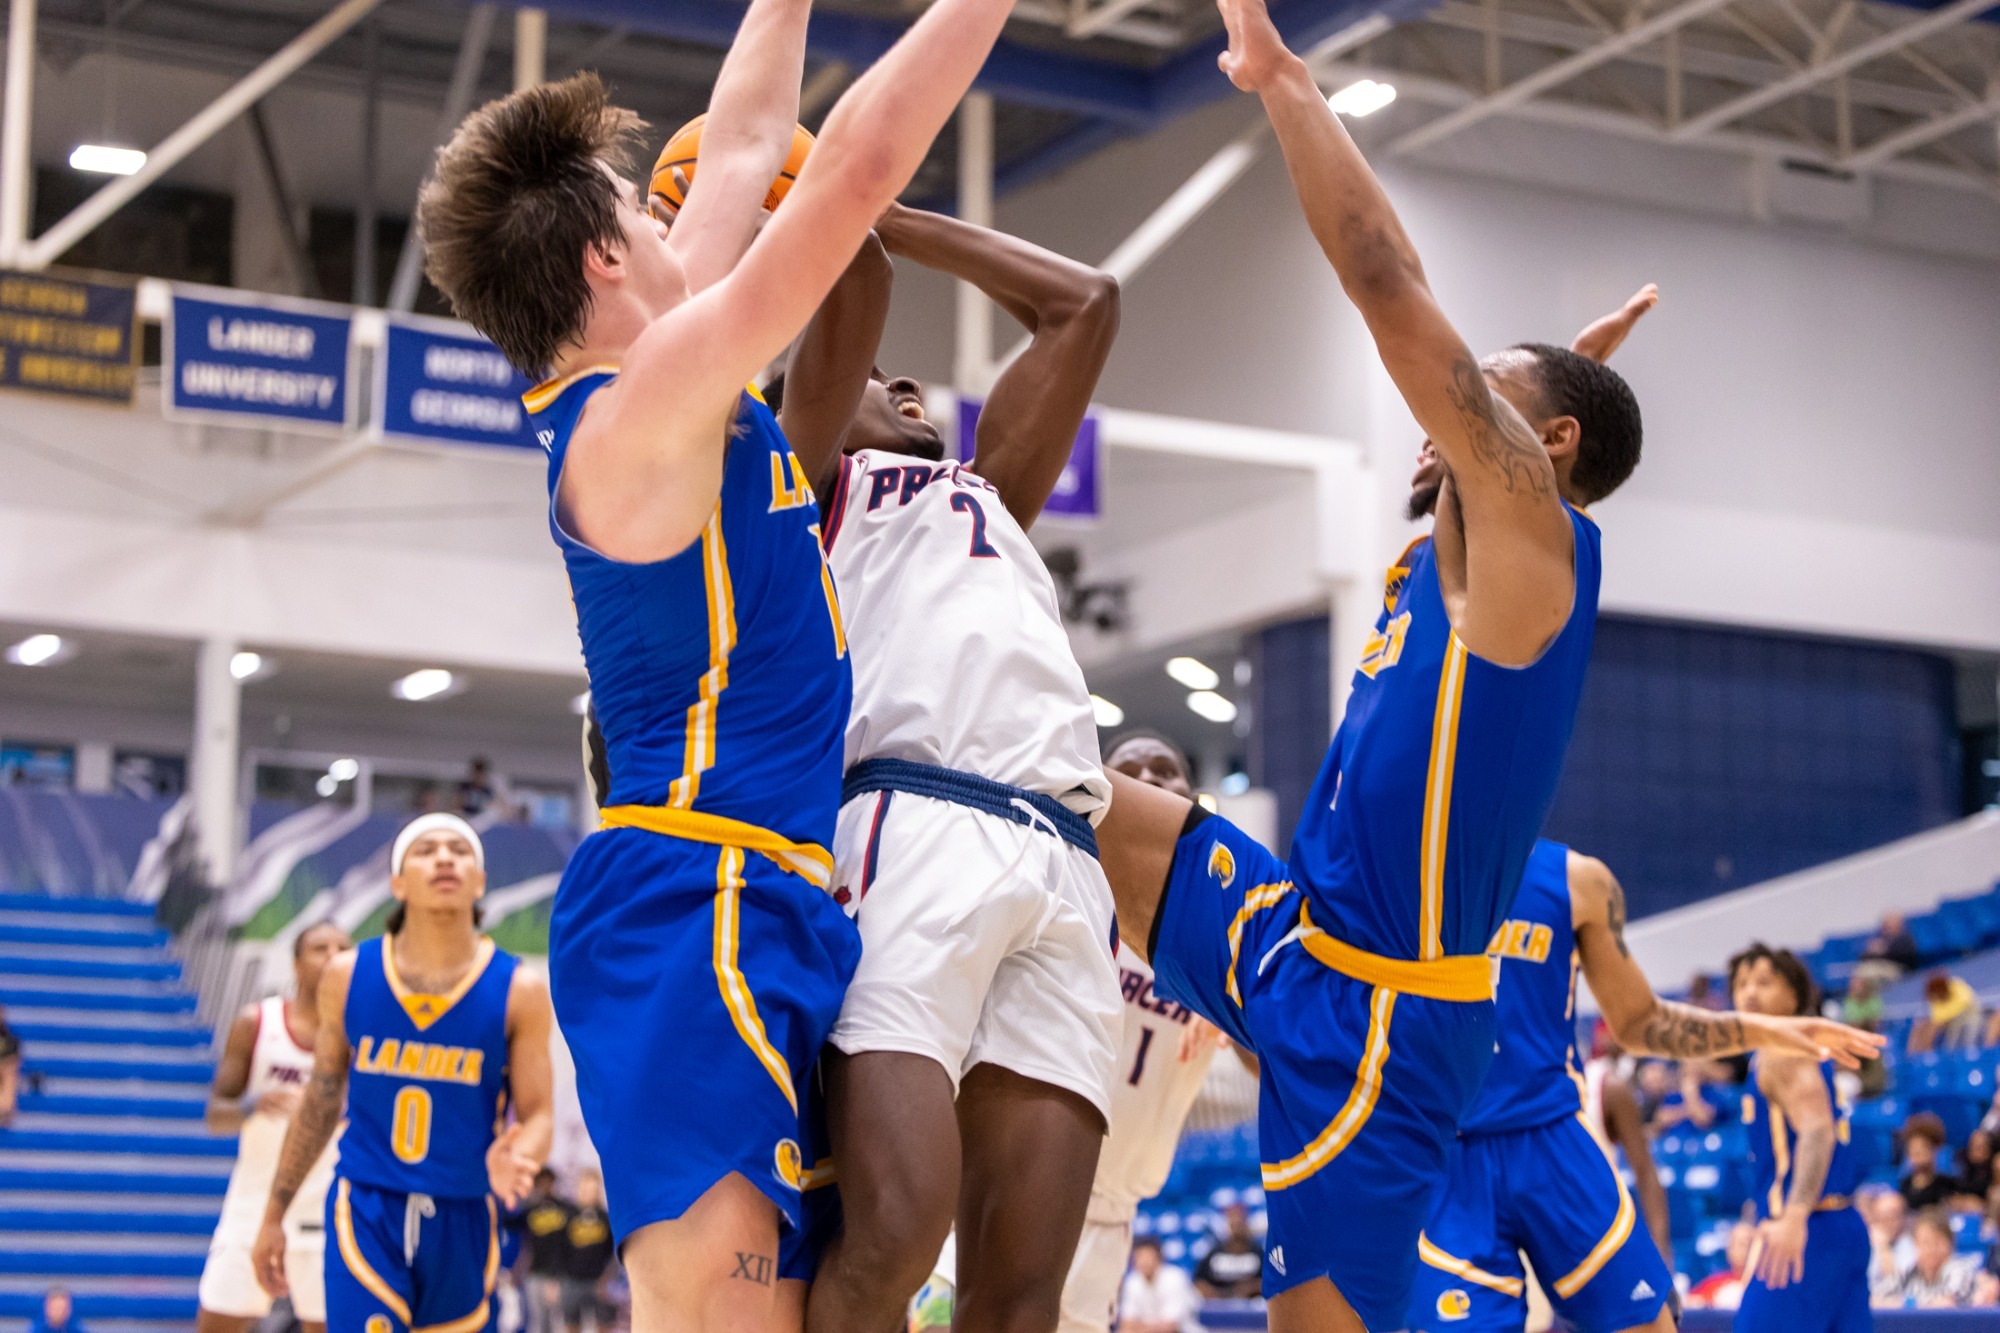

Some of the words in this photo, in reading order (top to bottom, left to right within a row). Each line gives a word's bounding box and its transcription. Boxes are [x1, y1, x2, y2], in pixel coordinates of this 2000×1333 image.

[182, 360, 338, 410] UNIVERSITY
[950, 491, 1001, 559] 2
[355, 1035, 485, 1087] LANDER
[1128, 1025, 1154, 1087] 1
[391, 1085, 433, 1165] 0
